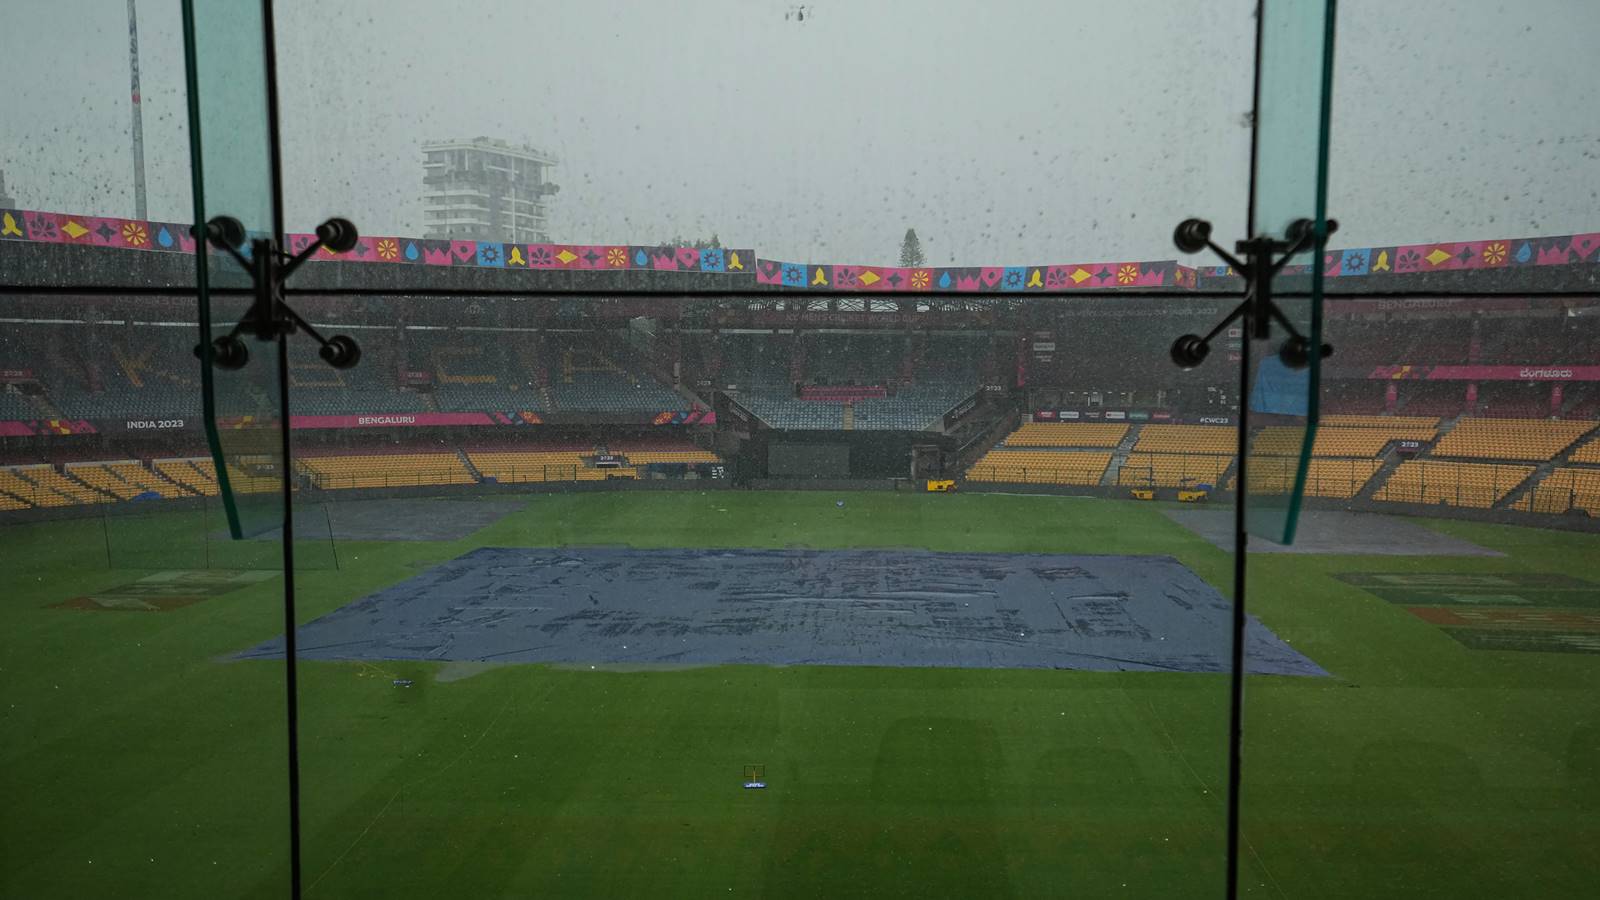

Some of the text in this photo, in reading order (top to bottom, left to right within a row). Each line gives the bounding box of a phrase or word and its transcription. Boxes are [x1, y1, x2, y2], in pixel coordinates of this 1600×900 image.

[127, 419, 184, 429] INDIA 2023
[358, 416, 415, 425] BENGALURU
[1200, 416, 1229, 424] #CWC23
